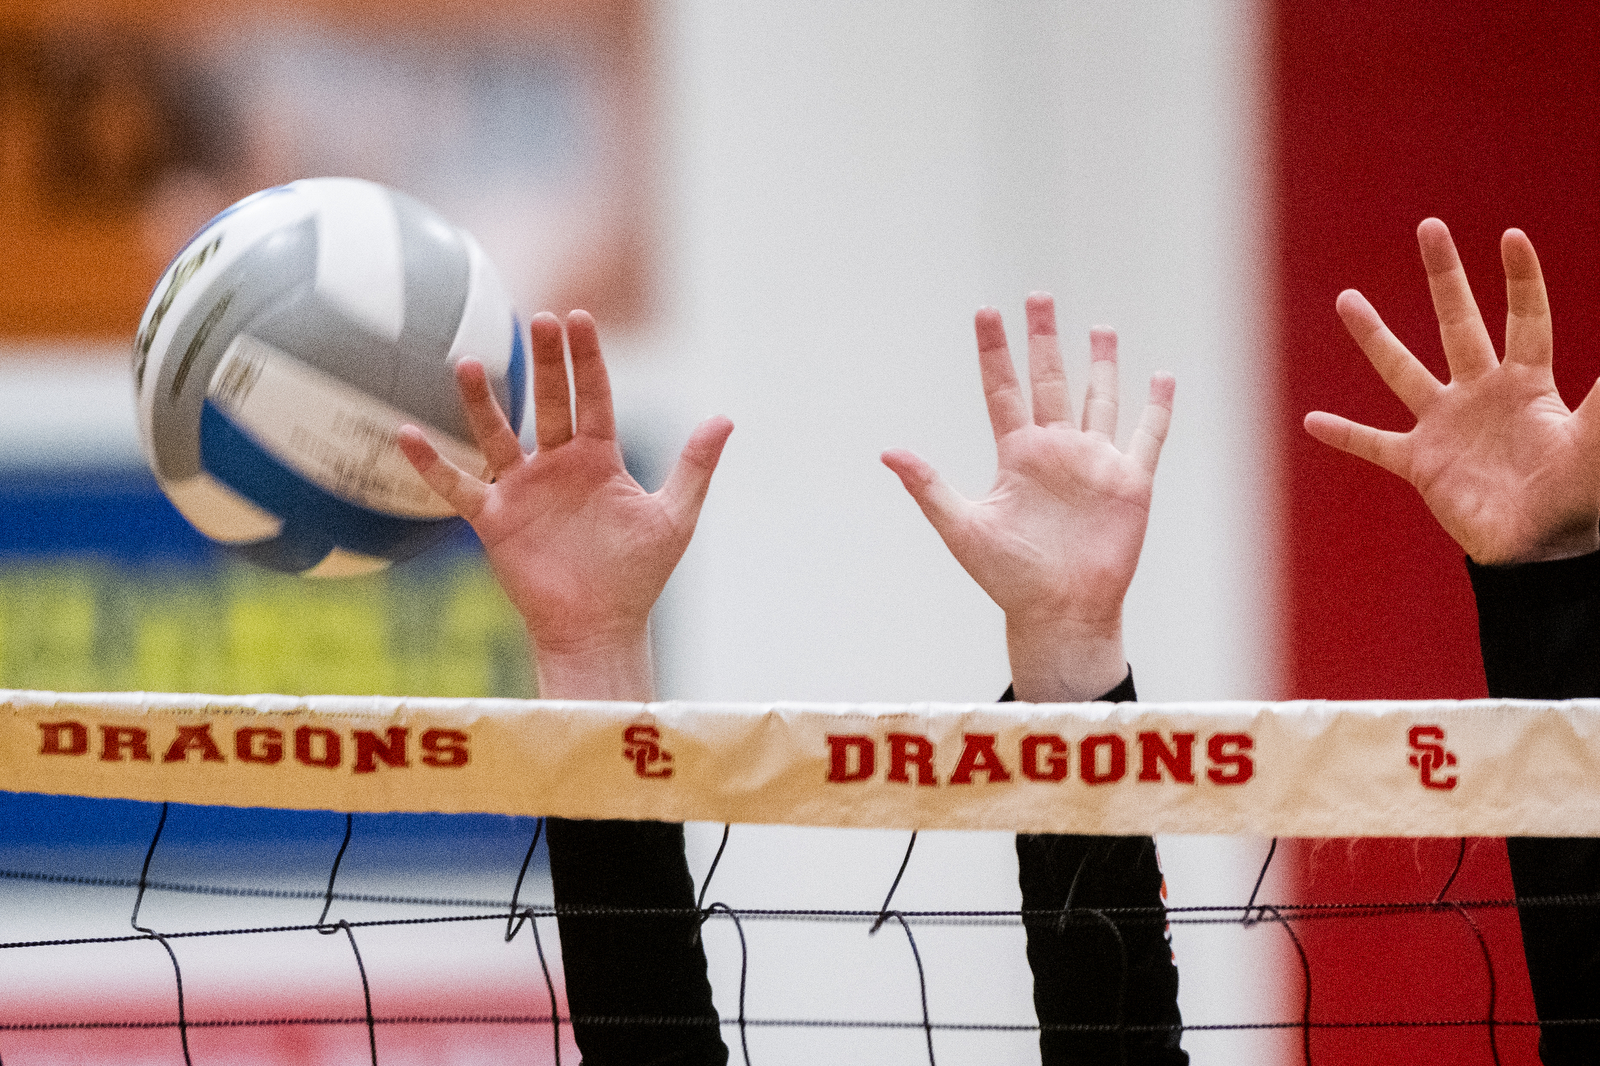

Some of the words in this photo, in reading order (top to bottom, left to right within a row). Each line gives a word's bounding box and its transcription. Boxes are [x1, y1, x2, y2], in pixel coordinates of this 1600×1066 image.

[37, 718, 472, 776] DRAGONS
[621, 723, 676, 781] SC
[824, 730, 1257, 788] DRAGONS
[1406, 724, 1459, 792] SC
